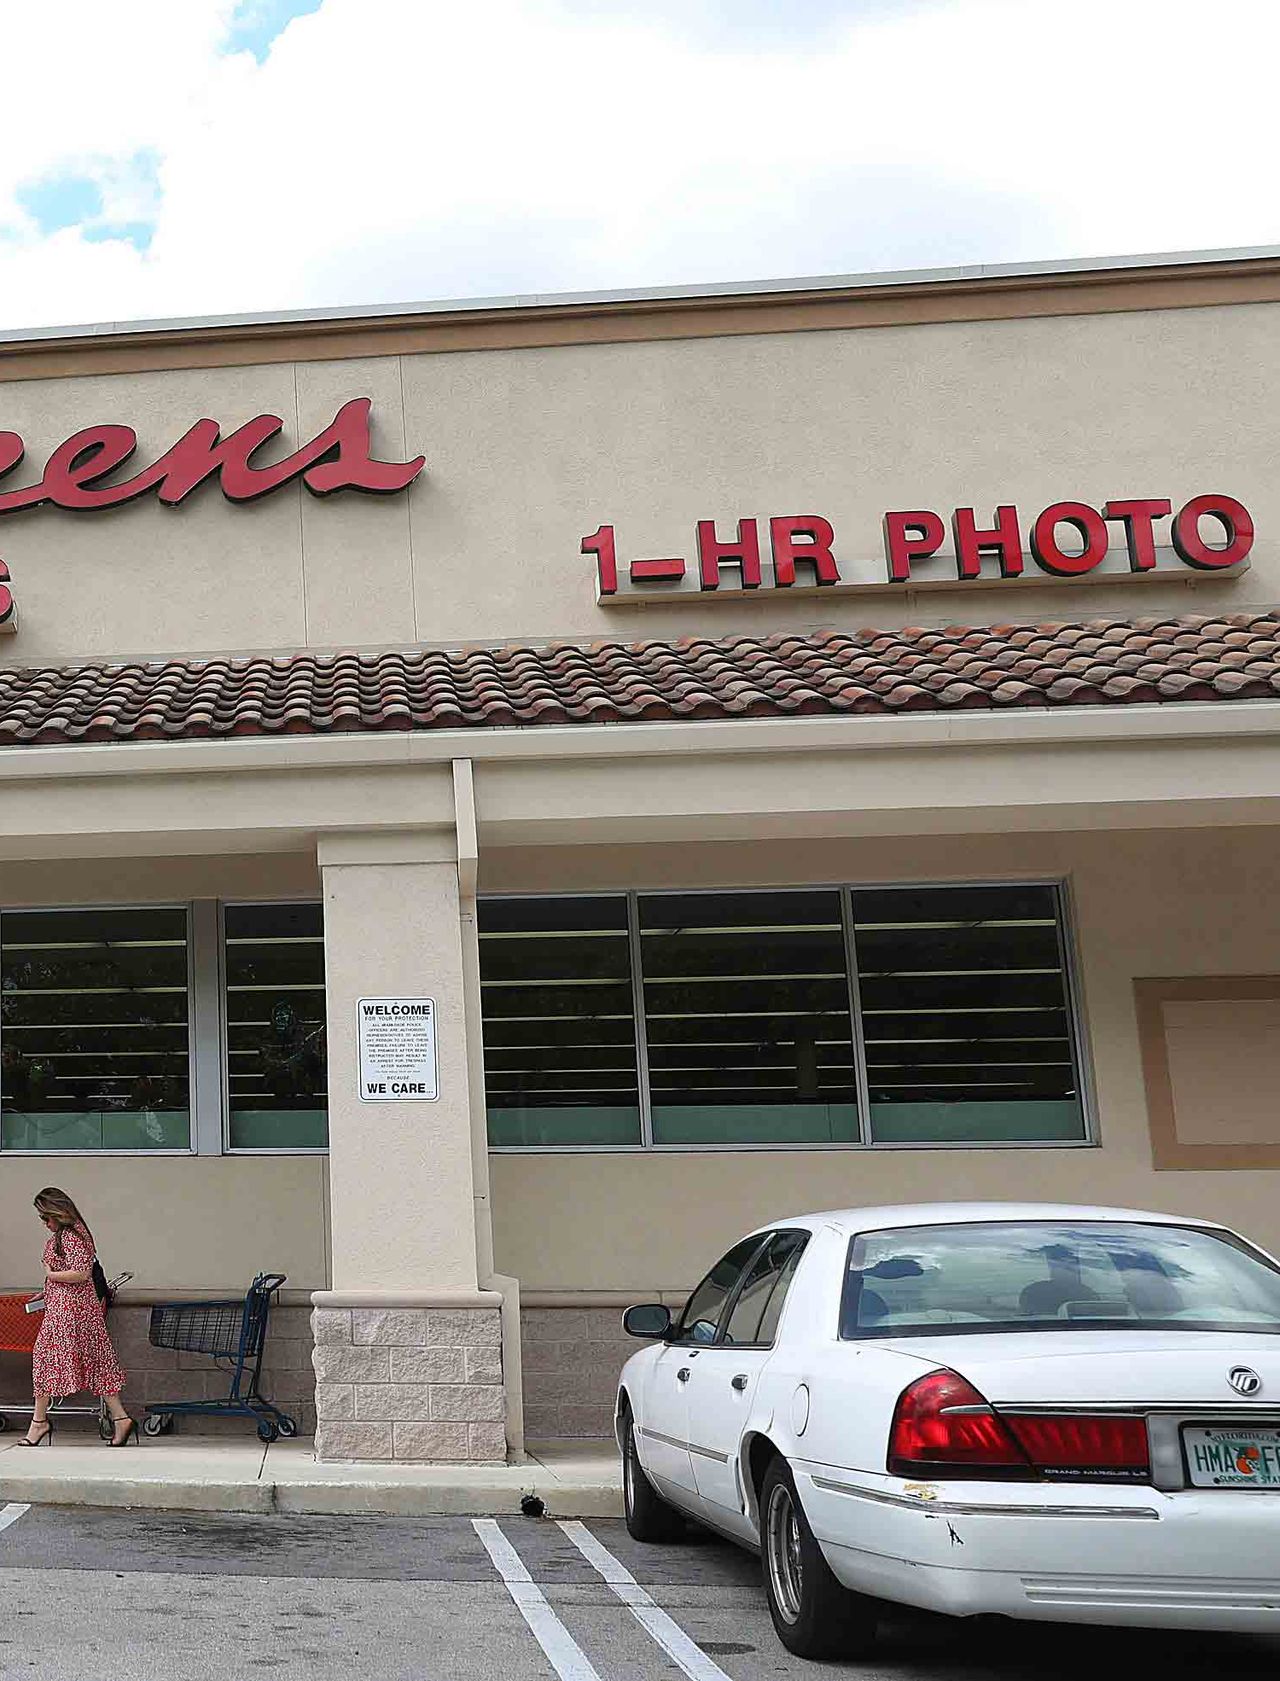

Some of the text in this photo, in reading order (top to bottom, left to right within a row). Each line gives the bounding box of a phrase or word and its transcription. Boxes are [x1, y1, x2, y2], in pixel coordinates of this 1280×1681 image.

[882, 494, 1255, 582] PHOTO
[363, 1005, 431, 1015] WELCOME
[367, 1083, 426, 1093] WE CARE
[1194, 1444, 1237, 1472] HMA
